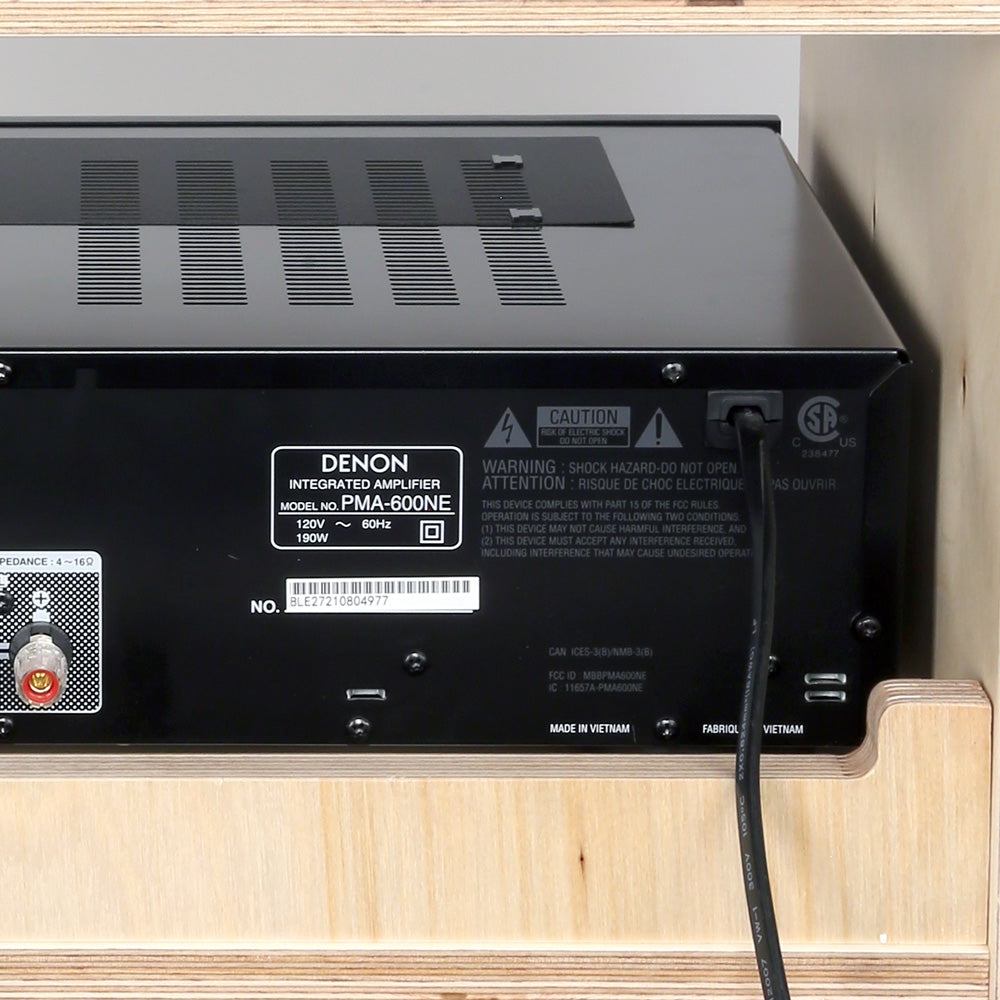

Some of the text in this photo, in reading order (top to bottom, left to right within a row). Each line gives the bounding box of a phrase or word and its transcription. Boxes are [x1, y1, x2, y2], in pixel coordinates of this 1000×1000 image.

[550, 409, 618, 424] CAUTION
[792, 438, 801, 448] C
[840, 438, 856, 447] US
[322, 454, 409, 473] DENON
[483, 460, 555, 473] WARNING
[569, 462, 607, 473] SHOCK
[611, 462, 677, 473] HAZARD-DO
[680, 462, 703, 473] NOT
[290, 479, 440, 490] INTEGRATED AMPLIFIER
[482, 476, 565, 490] ATTENTION
[579, 478, 619, 491] RISQUE
[624, 478, 638, 490] DE
[642, 478, 672, 490] CHOC
[676, 478, 744, 491] ELECTRIQUE
[770, 478, 789, 490] AS
[281, 495, 452, 511] MODEL NO. PMA-600NE
[482, 500, 501, 509] THIS
[504, 500, 533, 509] DEVICE
[535, 500, 578, 509] COMPLIES
[581, 500, 602, 509] WITH
[605, 500, 626, 509] PART
[630, 500, 639, 509] 15
[641, 500, 652, 509] OF
[655, 500, 670, 509] THE
[673, 500, 688, 509] FCC
[481, 512, 529, 521] OPERATION
[531, 512, 539, 521] IS
[542, 512, 578, 521] SUBJECT
[582, 512, 592, 521] TO
[595, 512, 610, 521] THE
[613, 512, 662, 521] FOLLOWING
[665, 512, 684, 521] TWO
[296, 519, 325, 529] 120V
[362, 519, 392, 529] 60Hz
[481, 524, 493, 534] (1)
[496, 524, 514, 533] THIS
[517, 524, 547, 533] DEVICE
[549, 524, 567, 533] MAY
[570, 524, 586, 533] NOT
[589, 524, 616, 533] CAUSE
[619, 524, 659, 533] HARMFUL
[728, 524, 747, 533] AND
[296, 533, 328, 543] 190W
[481, 536, 493, 546] (2)
[496, 536, 514, 546] THIS
[517, 536, 546, 546] DEVICE
[549, 536, 572, 546] MUST
[575, 536, 607, 546] ACCEPT
[609, 536, 627, 546] ANY
[630, 536, 691, 546] INTERFERENCE
[481, 549, 527, 558] INCLUDING
[530, 549, 590, 558] INTERFERENCE
[594, 549, 614, 558] THAT
[617, 549, 634, 558] MAY
[637, 549, 665, 558] CAUSE
[667, 549, 716, 558] UNDESIRED
[251, 601, 280, 613] NO.
[549, 647, 566, 656] CAN
[549, 684, 557, 692] IC
[550, 724, 630, 734] MADE IN VIETNAM
[763, 725, 804, 734] VIETNAM
[744, 852, 754, 890] 300V
[751, 905, 764, 942] VW-1
